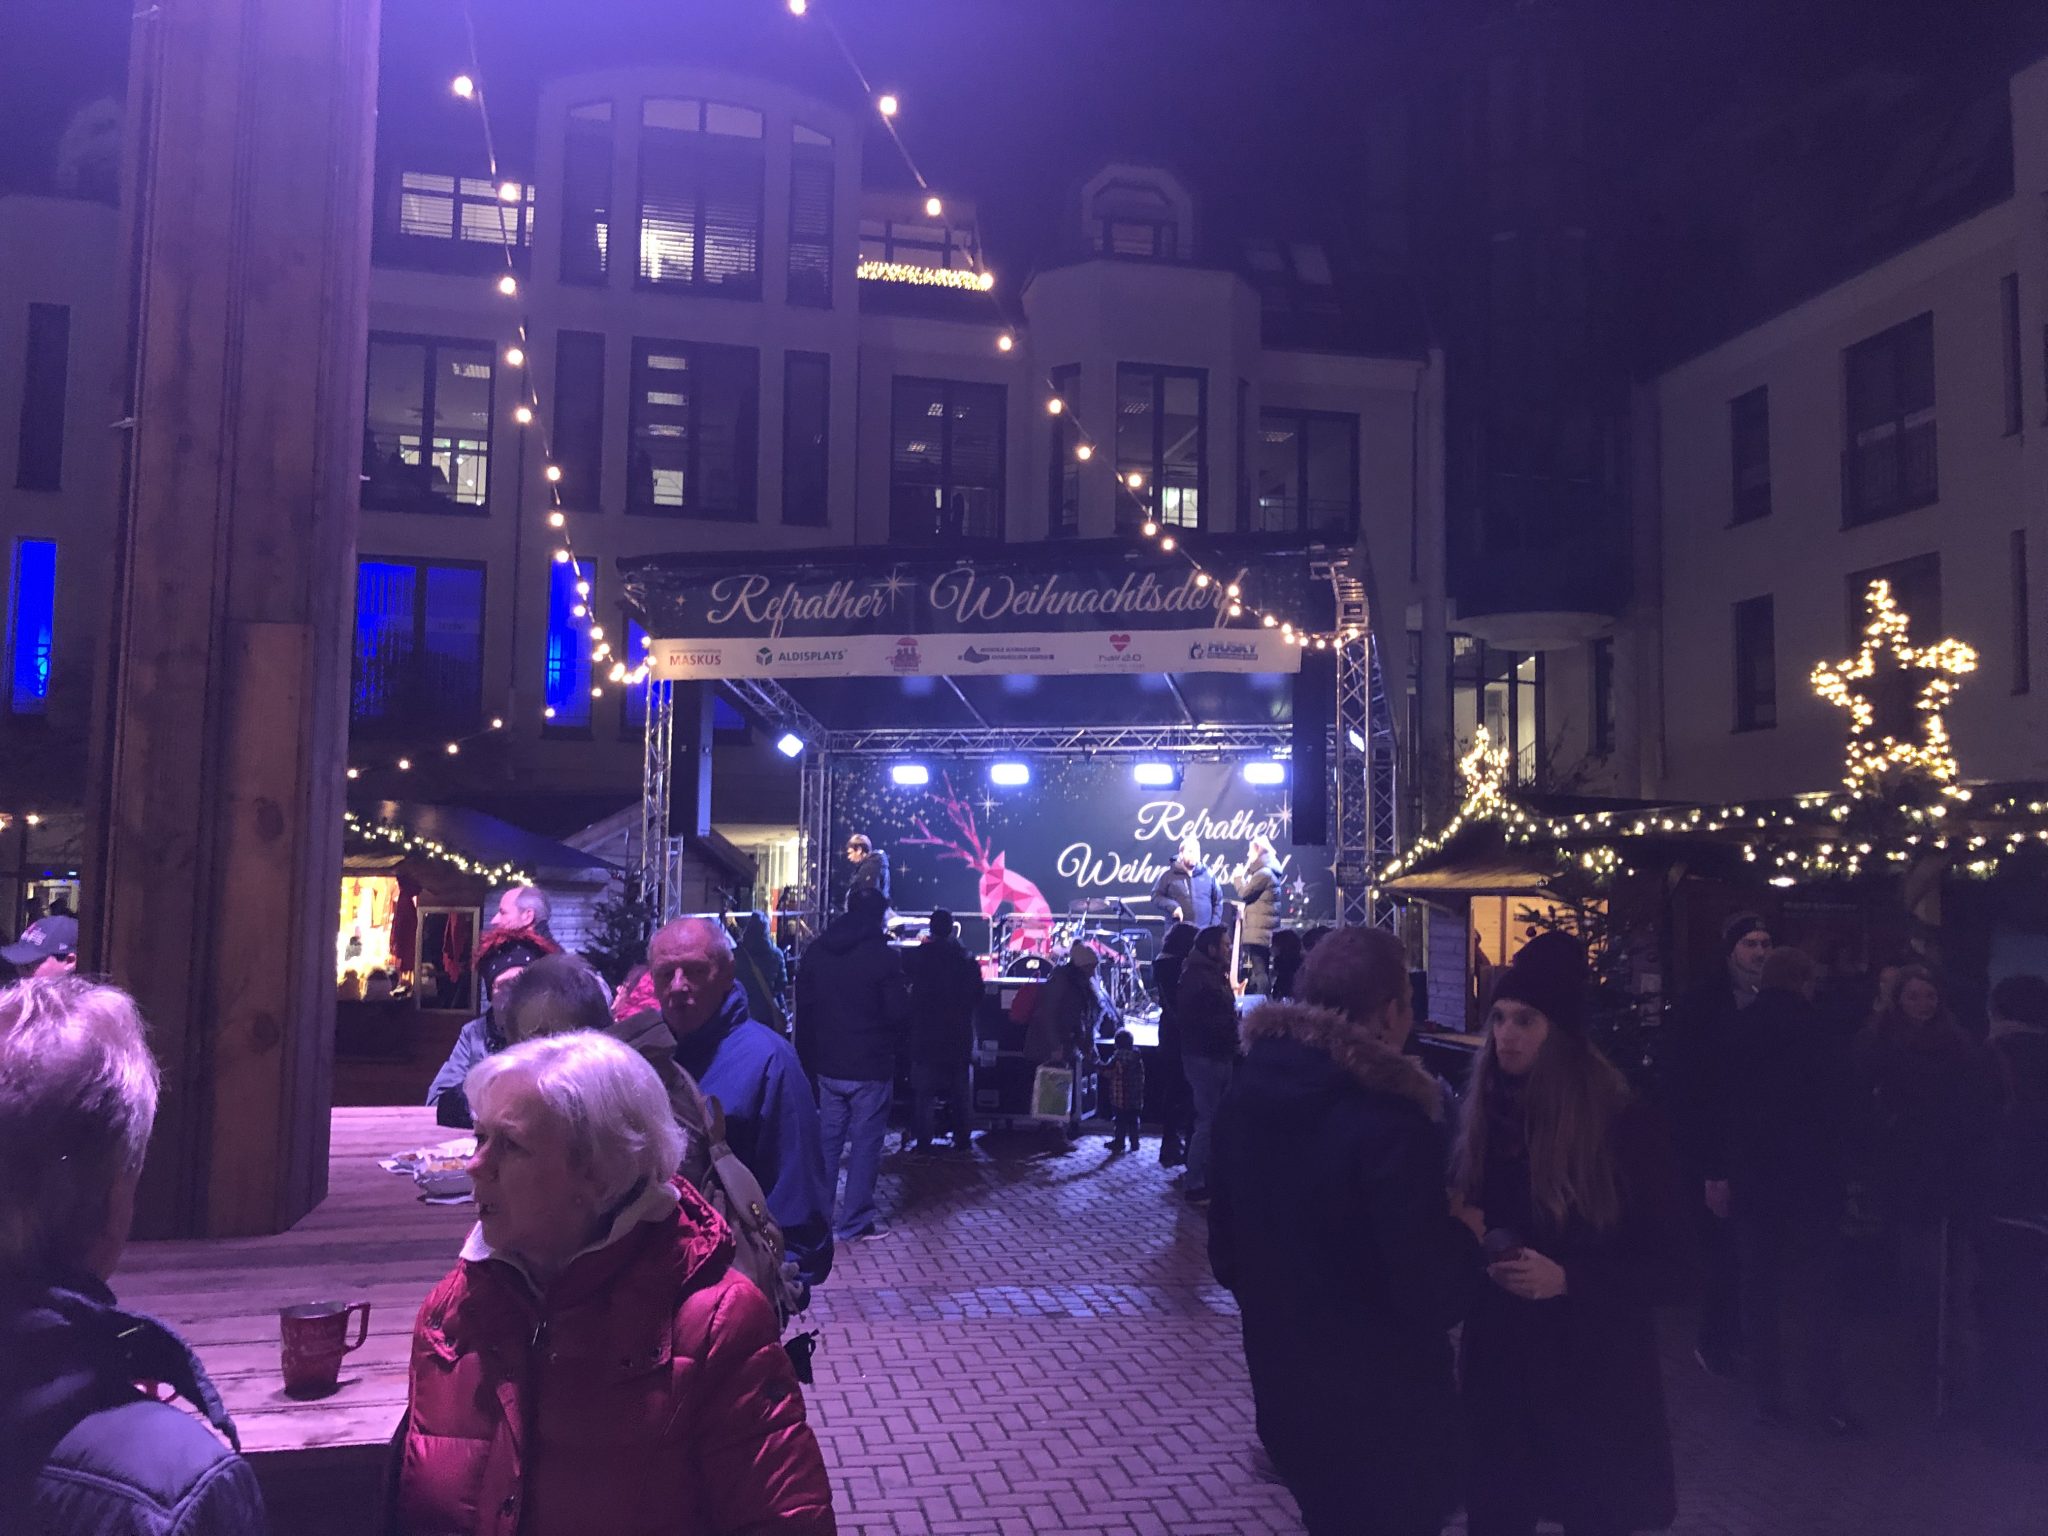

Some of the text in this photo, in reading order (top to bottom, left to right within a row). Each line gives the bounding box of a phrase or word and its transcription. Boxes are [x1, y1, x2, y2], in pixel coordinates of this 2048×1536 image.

[706, 567, 1249, 639] Refrather Weihnachtsdorf
[669, 654, 722, 666] MASKUS
[778, 650, 845, 662] ALDISPLAYS
[1133, 801, 1281, 841] Refrather
